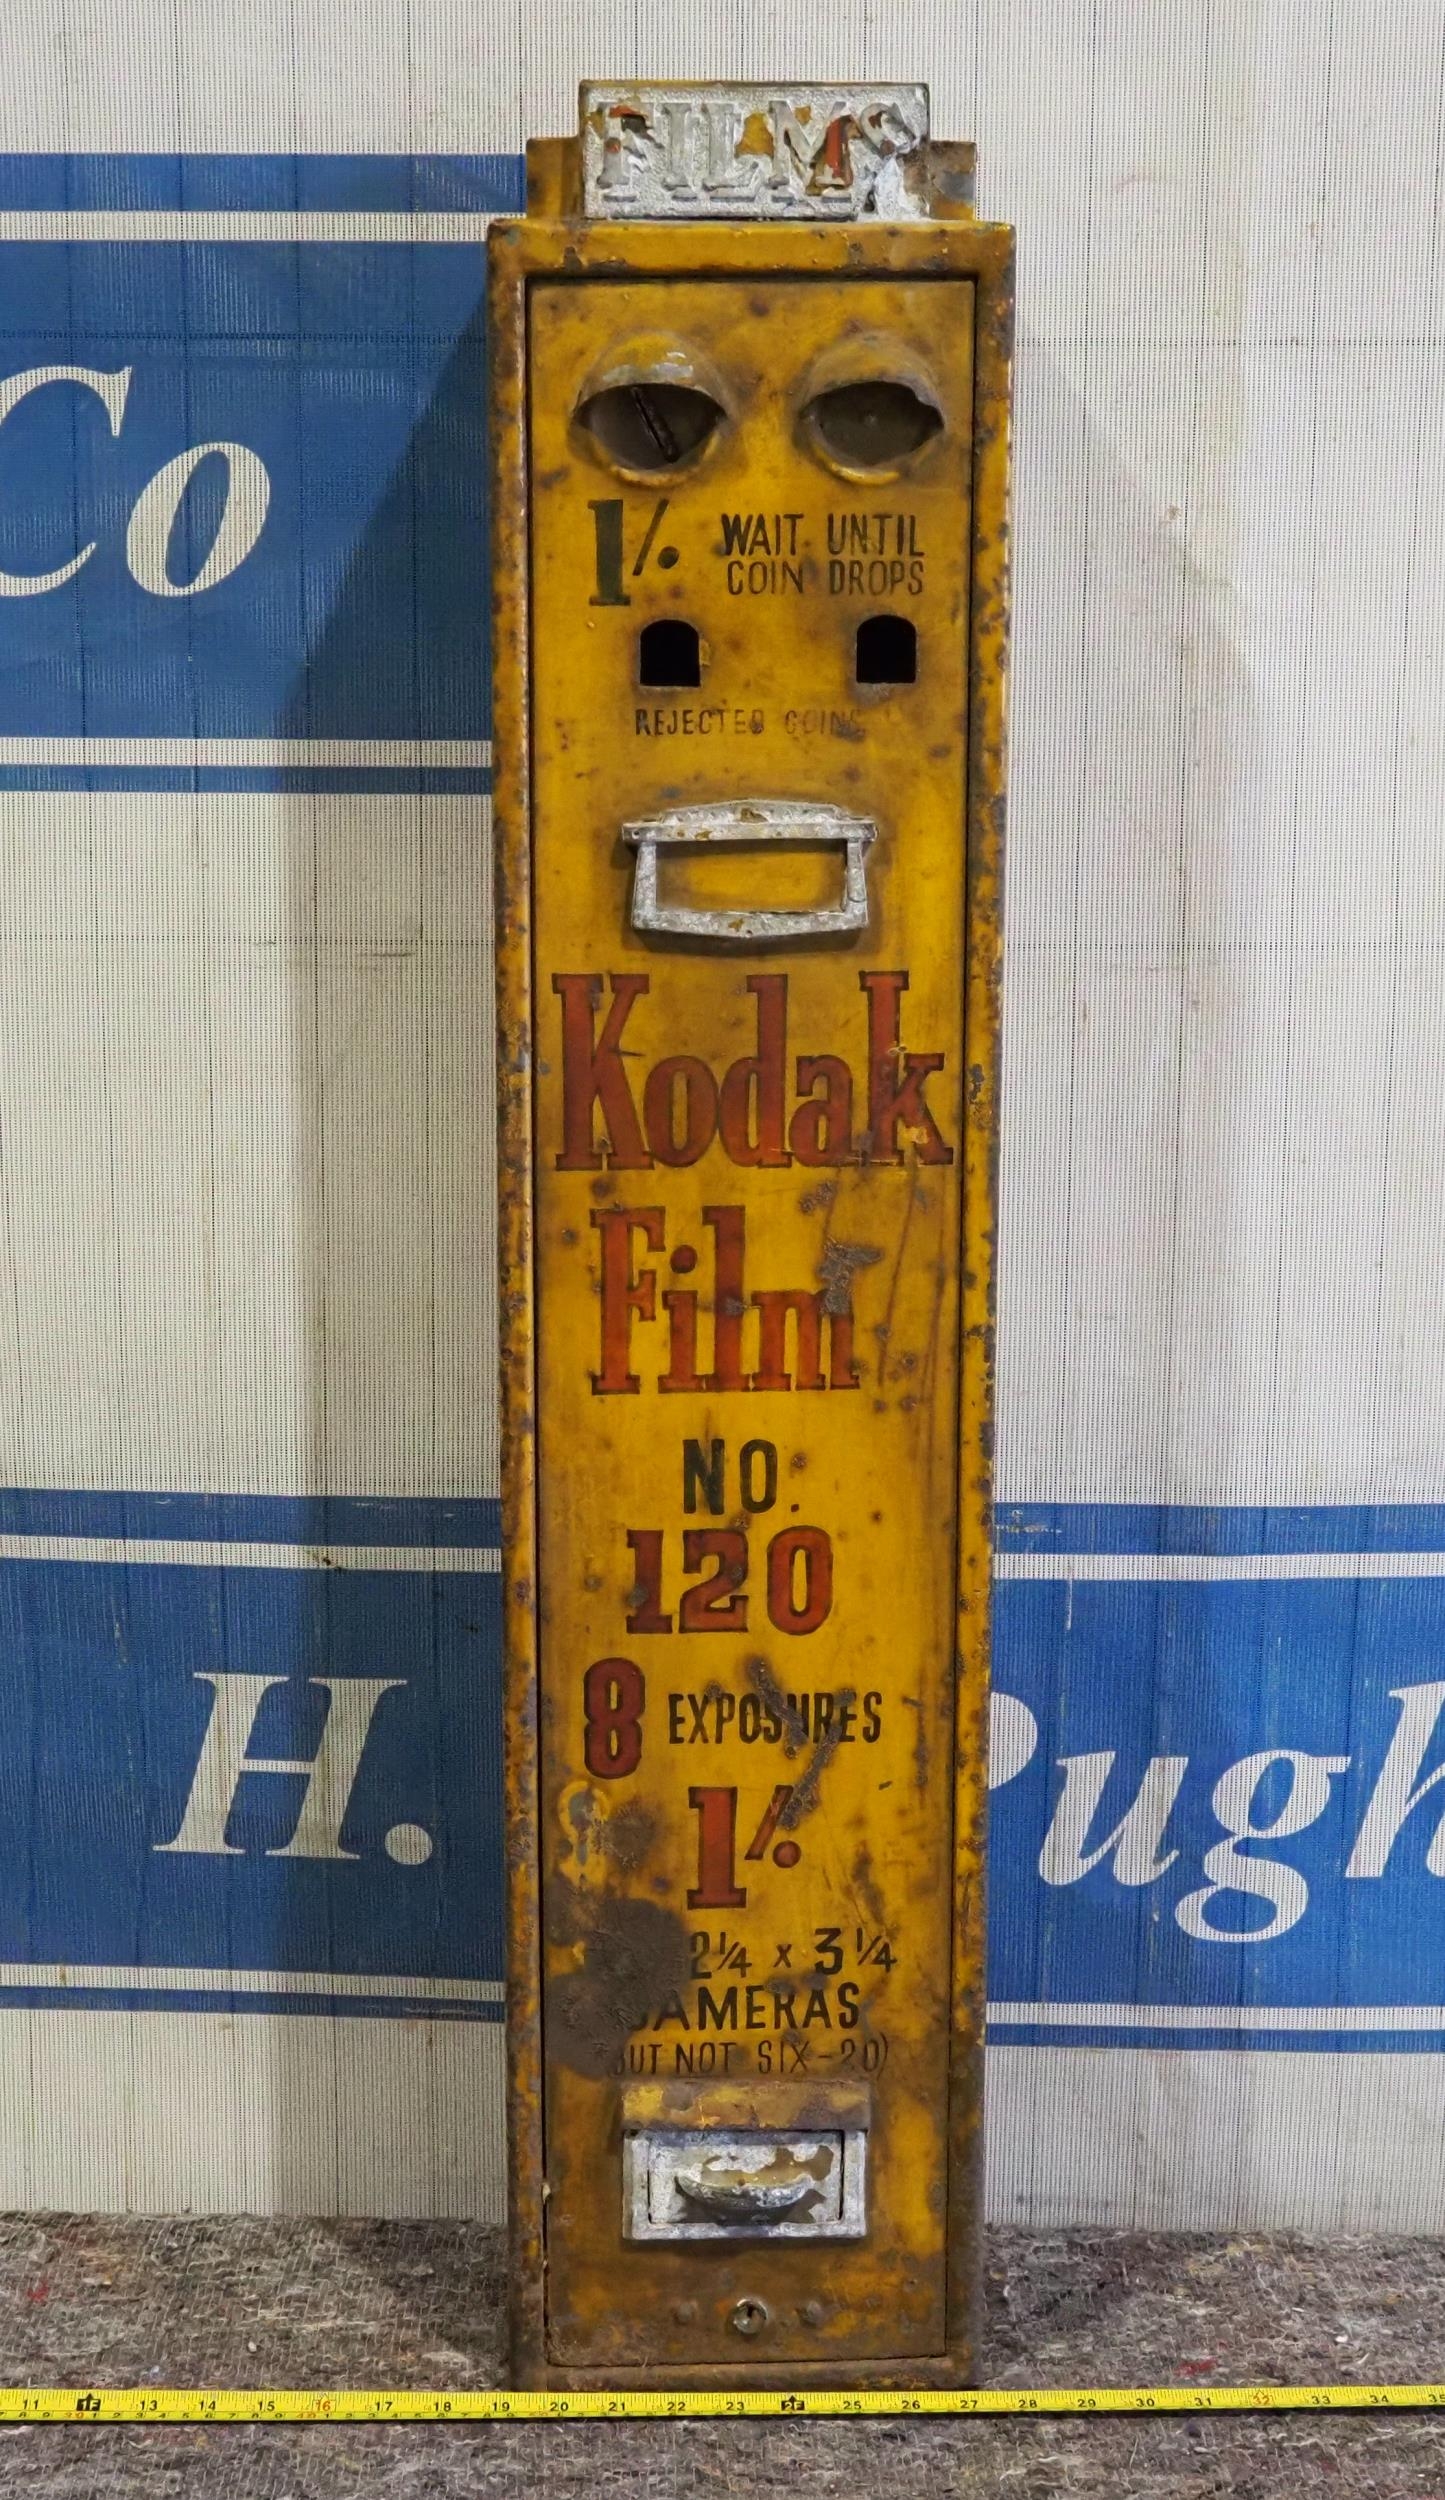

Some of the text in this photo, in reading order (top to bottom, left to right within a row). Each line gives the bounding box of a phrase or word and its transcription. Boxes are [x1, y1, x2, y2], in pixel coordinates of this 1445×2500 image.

[721, 513, 925, 557] WAIT UNTIL
[728, 560, 924, 597] COIN DROPS
[634, 708, 766, 737] REJECTED
[551, 970, 954, 1170] Kodak
[590, 1205, 860, 1395] Film
[626, 1525, 834, 1636] 120
[153, 1672, 433, 1866] H.
[583, 1657, 882, 1779] 8 EXPOSURES
[675, 2042, 736, 2074] NOT
